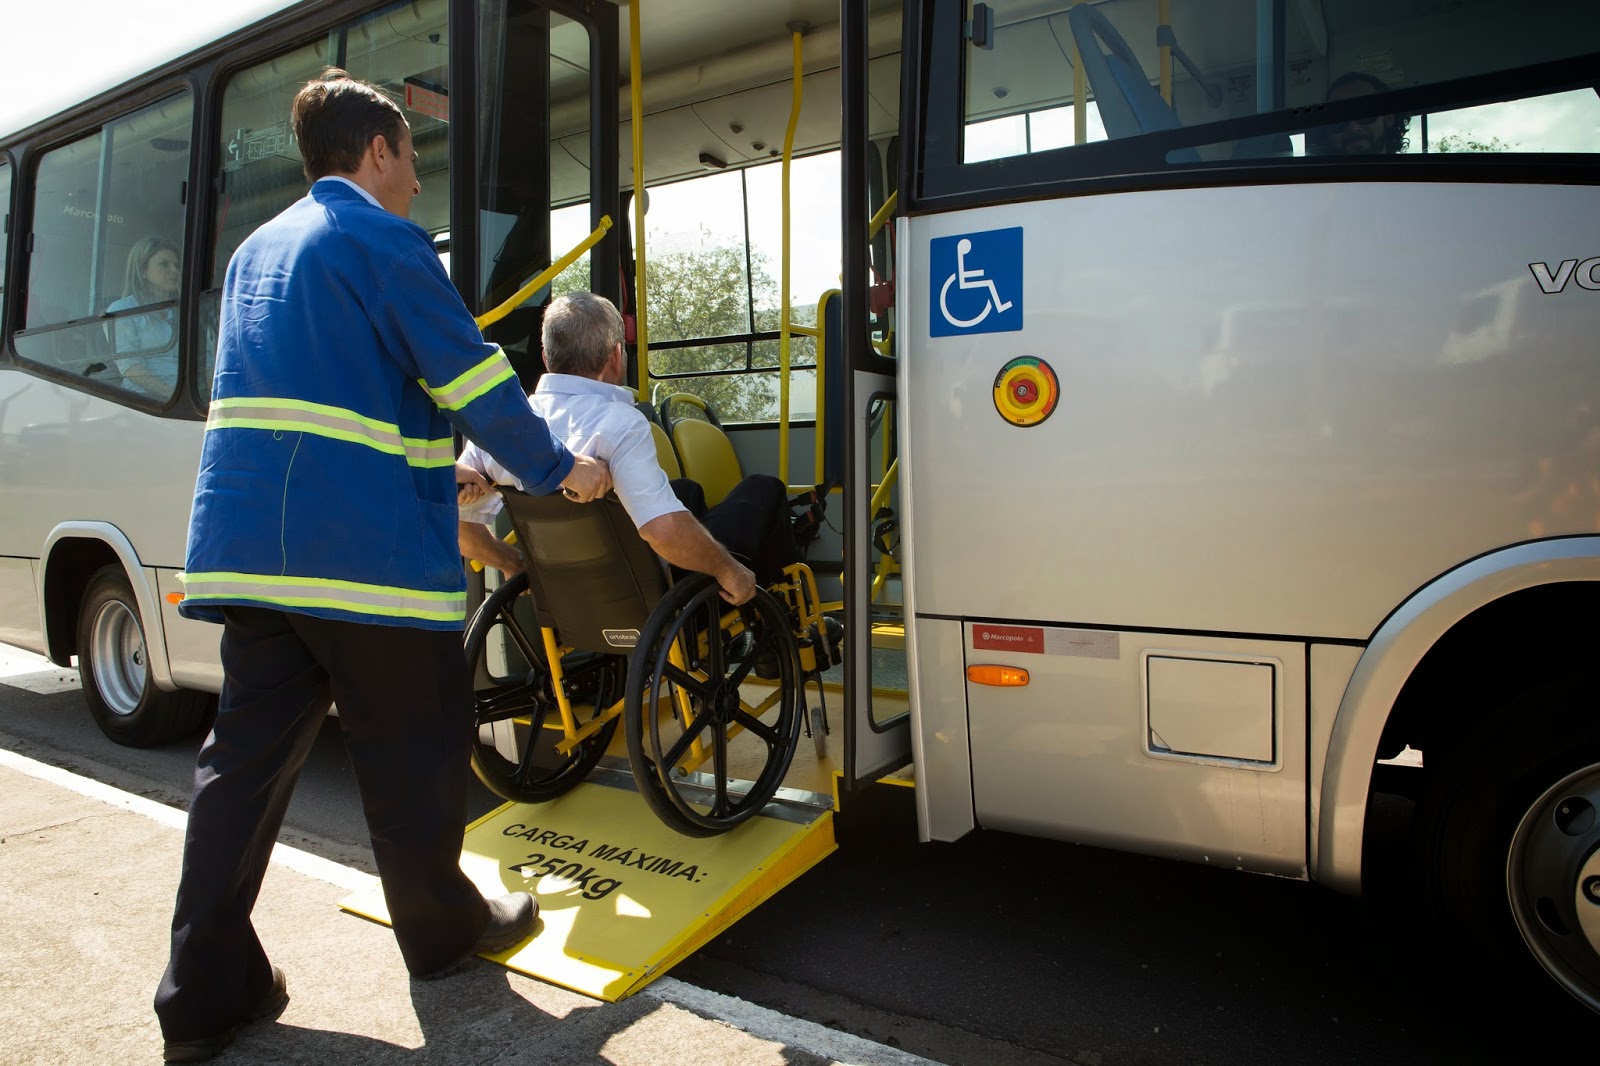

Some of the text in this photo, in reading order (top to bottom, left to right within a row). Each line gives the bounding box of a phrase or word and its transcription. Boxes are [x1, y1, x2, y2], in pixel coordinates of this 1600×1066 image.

[990, 633, 1024, 642] Marcopolo
[502, 823, 708, 883] CARGA MÁXIMA:
[508, 853, 623, 901] 250kg
